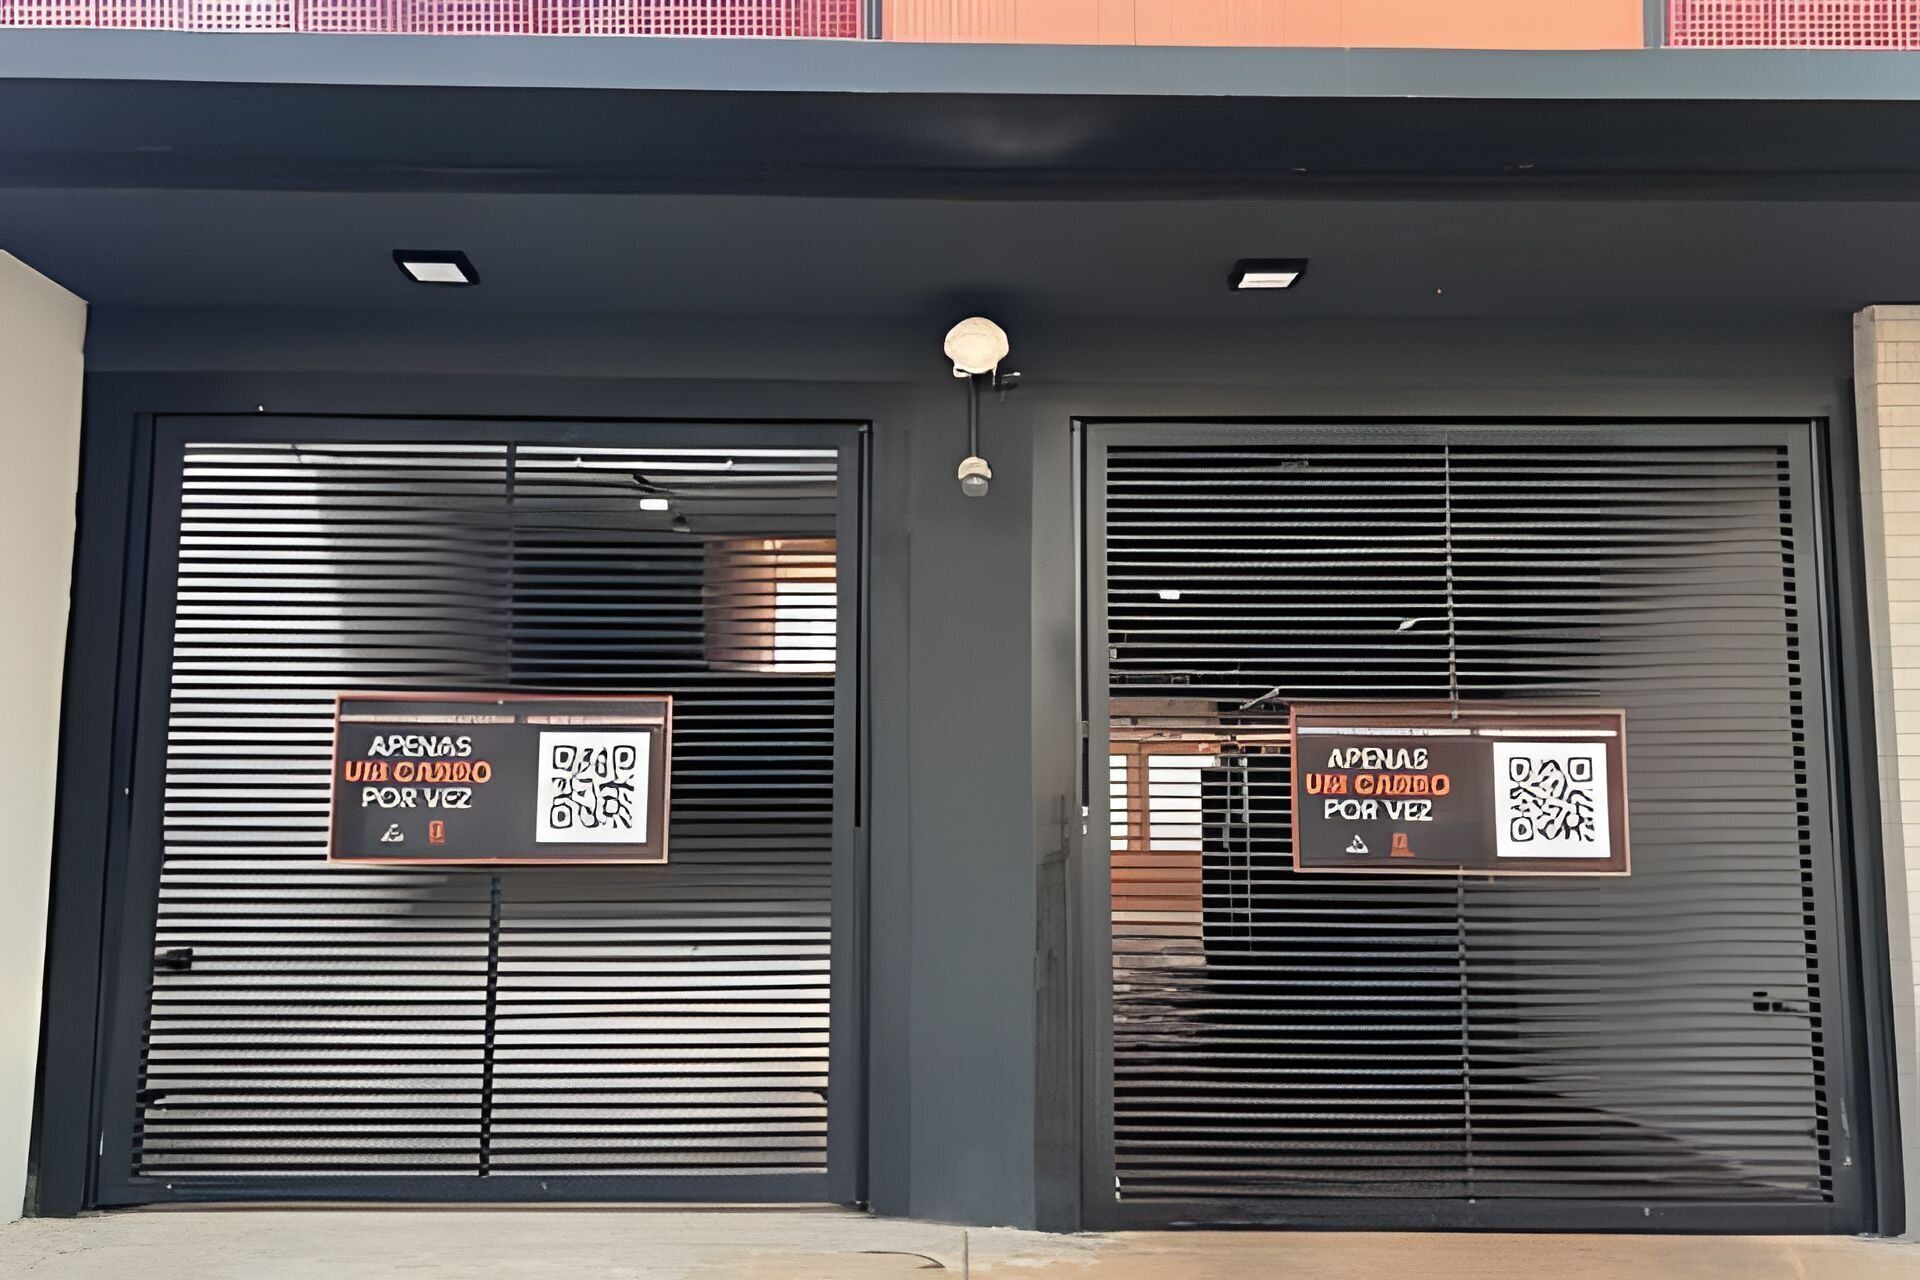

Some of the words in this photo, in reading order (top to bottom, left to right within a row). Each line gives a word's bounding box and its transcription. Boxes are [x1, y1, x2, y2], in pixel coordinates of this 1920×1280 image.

[367, 735, 472, 757] APENAS
[1327, 747, 1429, 770] APENAS
[362, 787, 417, 808] POR
[423, 787, 472, 809] VEZ
[1324, 799, 1378, 820] POR
[1381, 799, 1433, 821] VEZ
